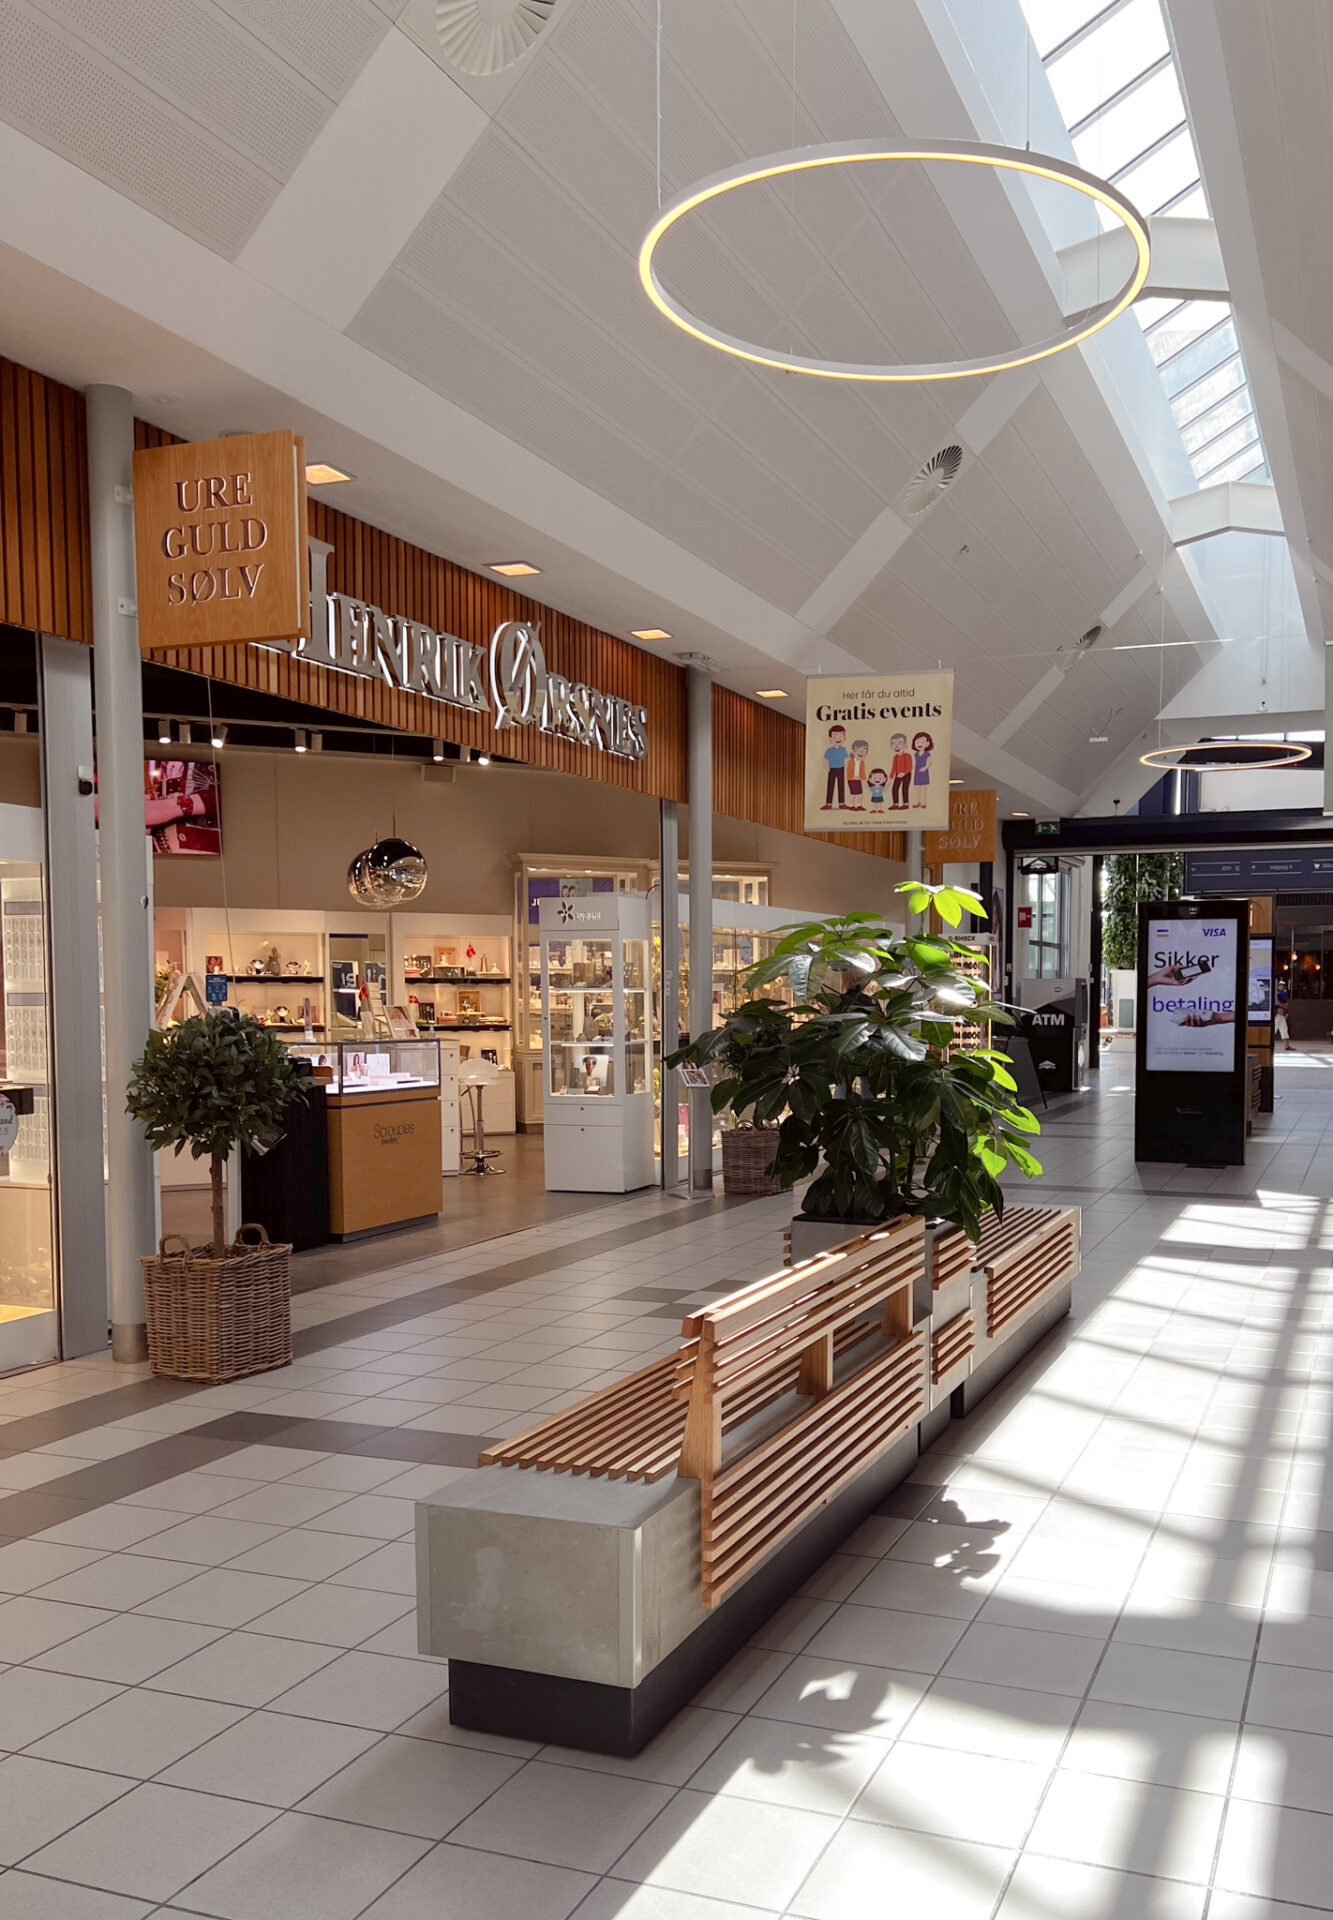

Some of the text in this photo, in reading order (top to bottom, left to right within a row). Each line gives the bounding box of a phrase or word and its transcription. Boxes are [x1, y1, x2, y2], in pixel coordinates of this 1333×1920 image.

[174, 472, 253, 514] URE
[161, 517, 268, 560] GULD
[168, 563, 265, 607] SØLV
[842, 688, 916, 701] Her får du altid
[816, 702, 942, 722] Gratis events
[950, 818, 984, 833] ULD
[1202, 928, 1227, 937] VISA
[1153, 950, 1220, 969] Sikker
[1152, 996, 1235, 1014] betaling
[1032, 1013, 1065, 1026] ATM
